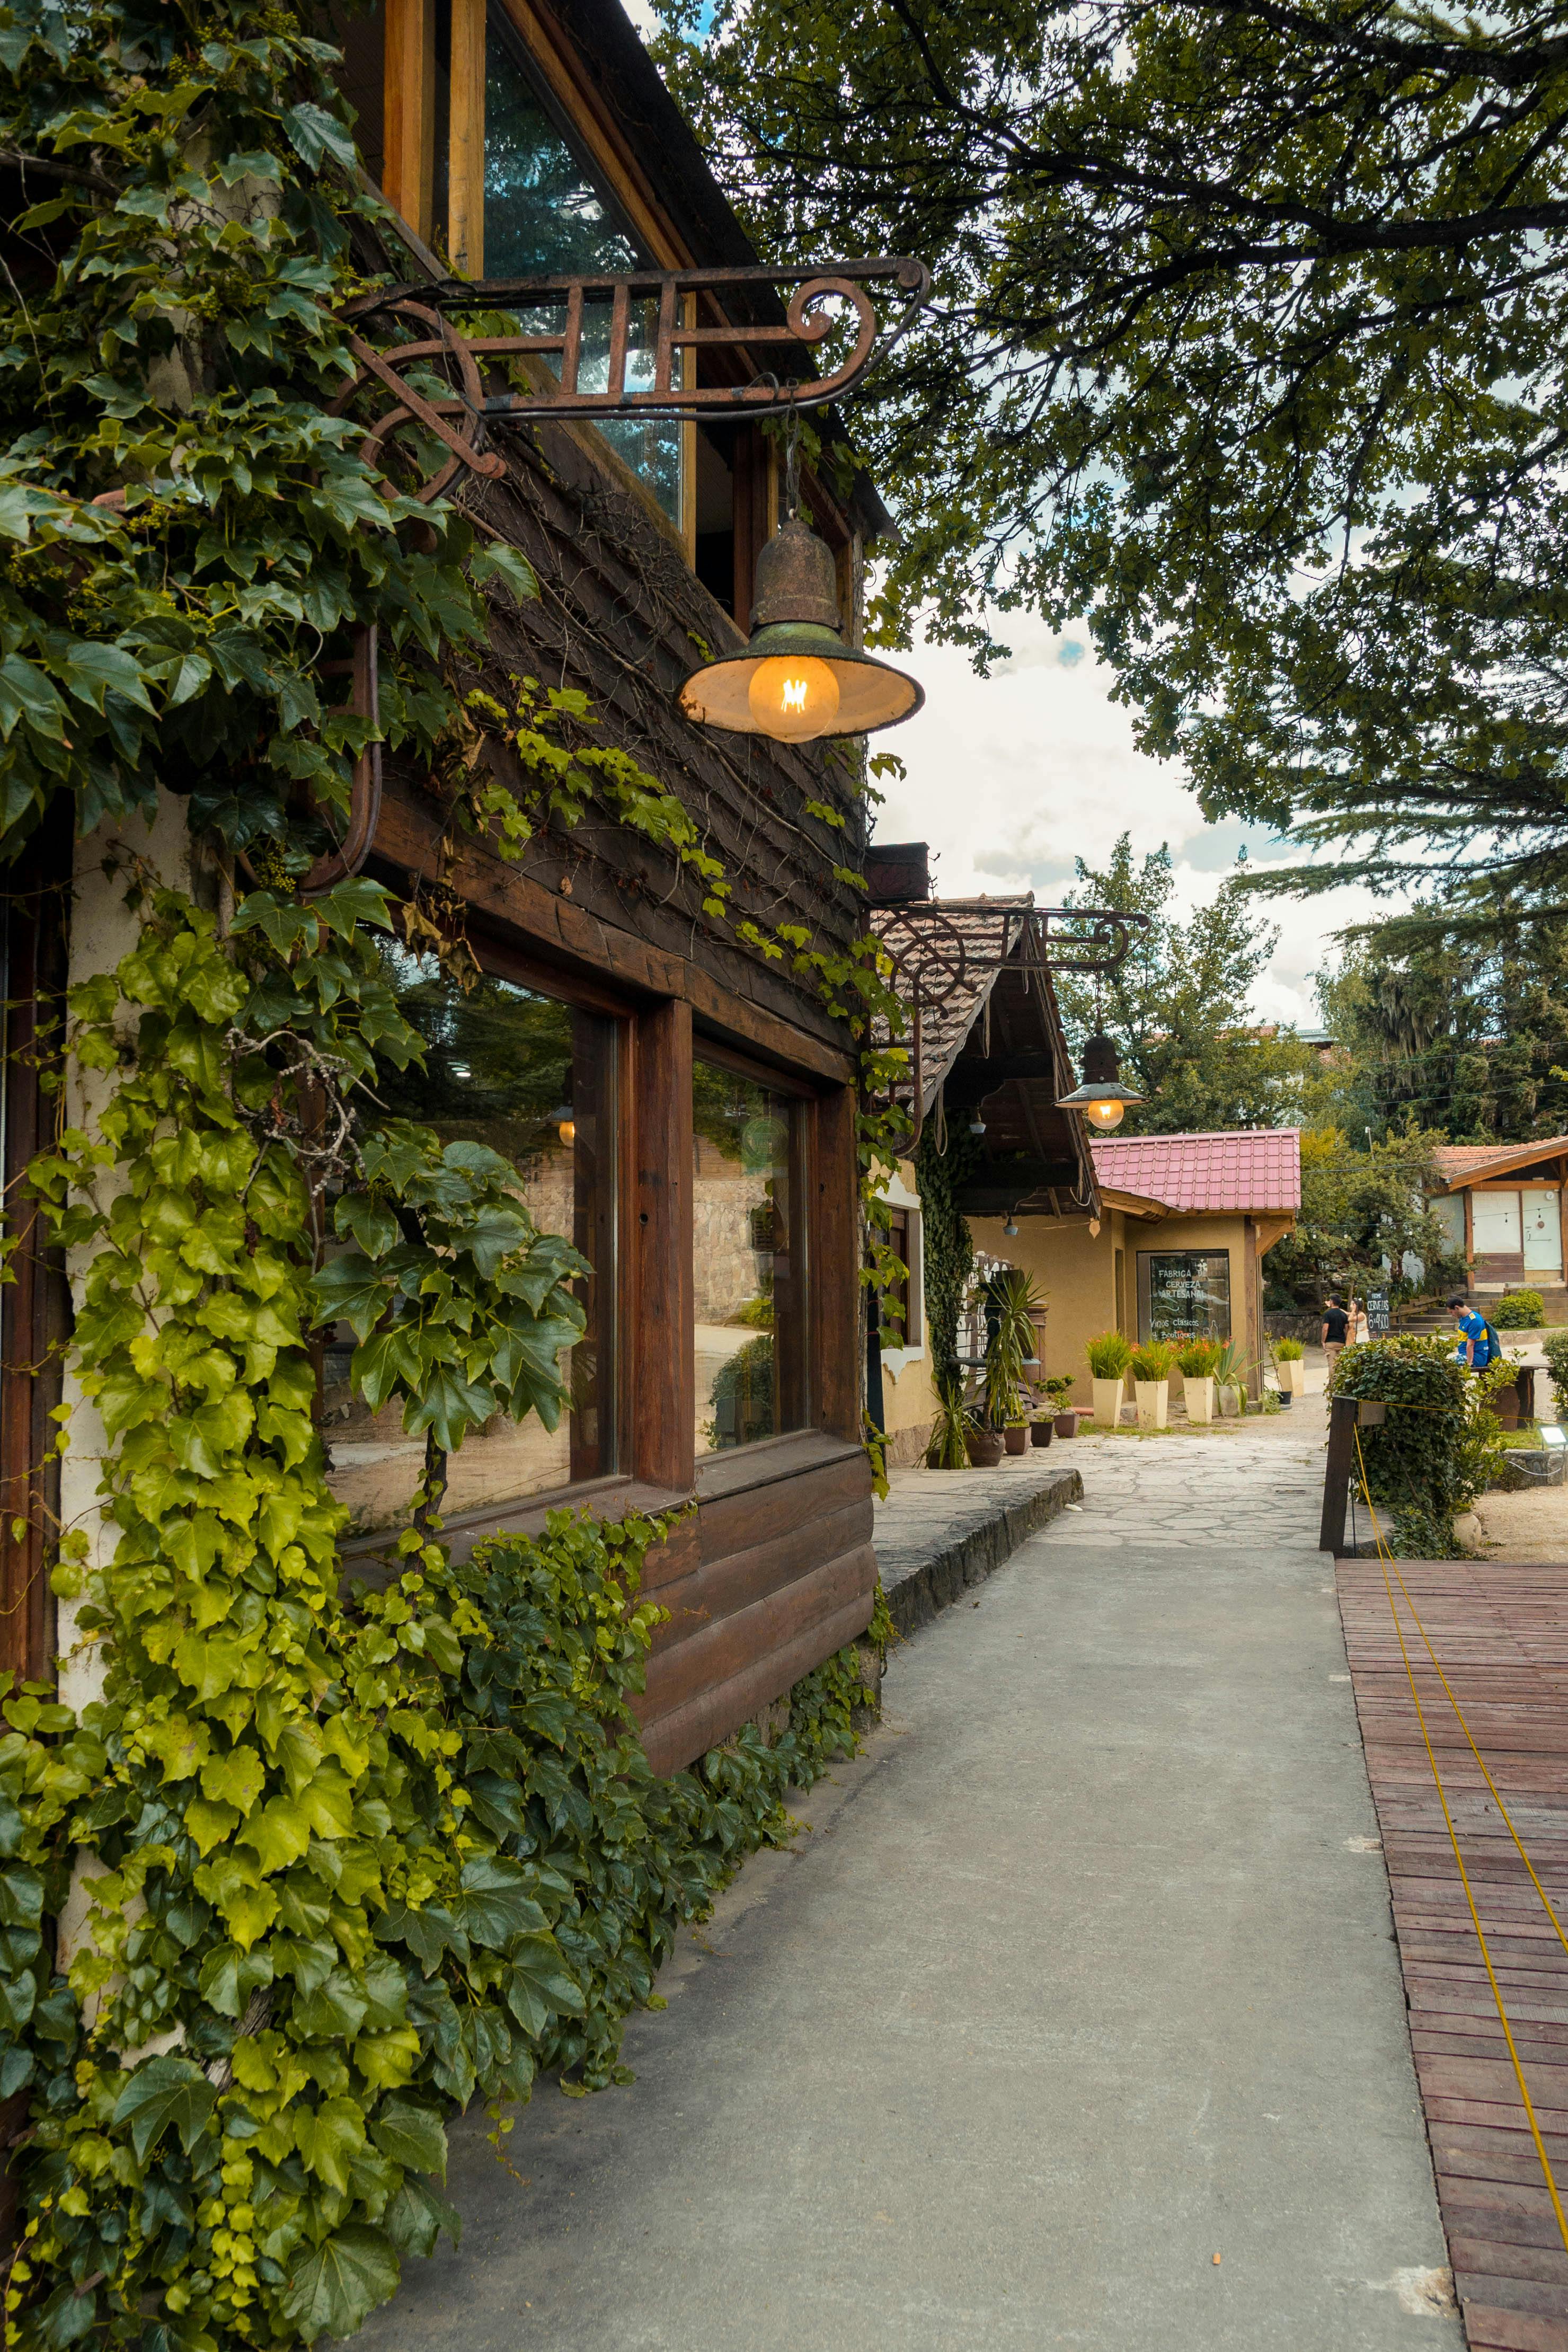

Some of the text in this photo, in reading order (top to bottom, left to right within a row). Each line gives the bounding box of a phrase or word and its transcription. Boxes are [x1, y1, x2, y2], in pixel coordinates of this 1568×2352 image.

[1158, 1269, 1191, 1278] FABRICA
[1161, 1289, 1207, 1298] ARTESANAL
[1367, 1300, 1388, 1311] CERVEZAS
[1149, 1319, 1169, 1327] Vinos
